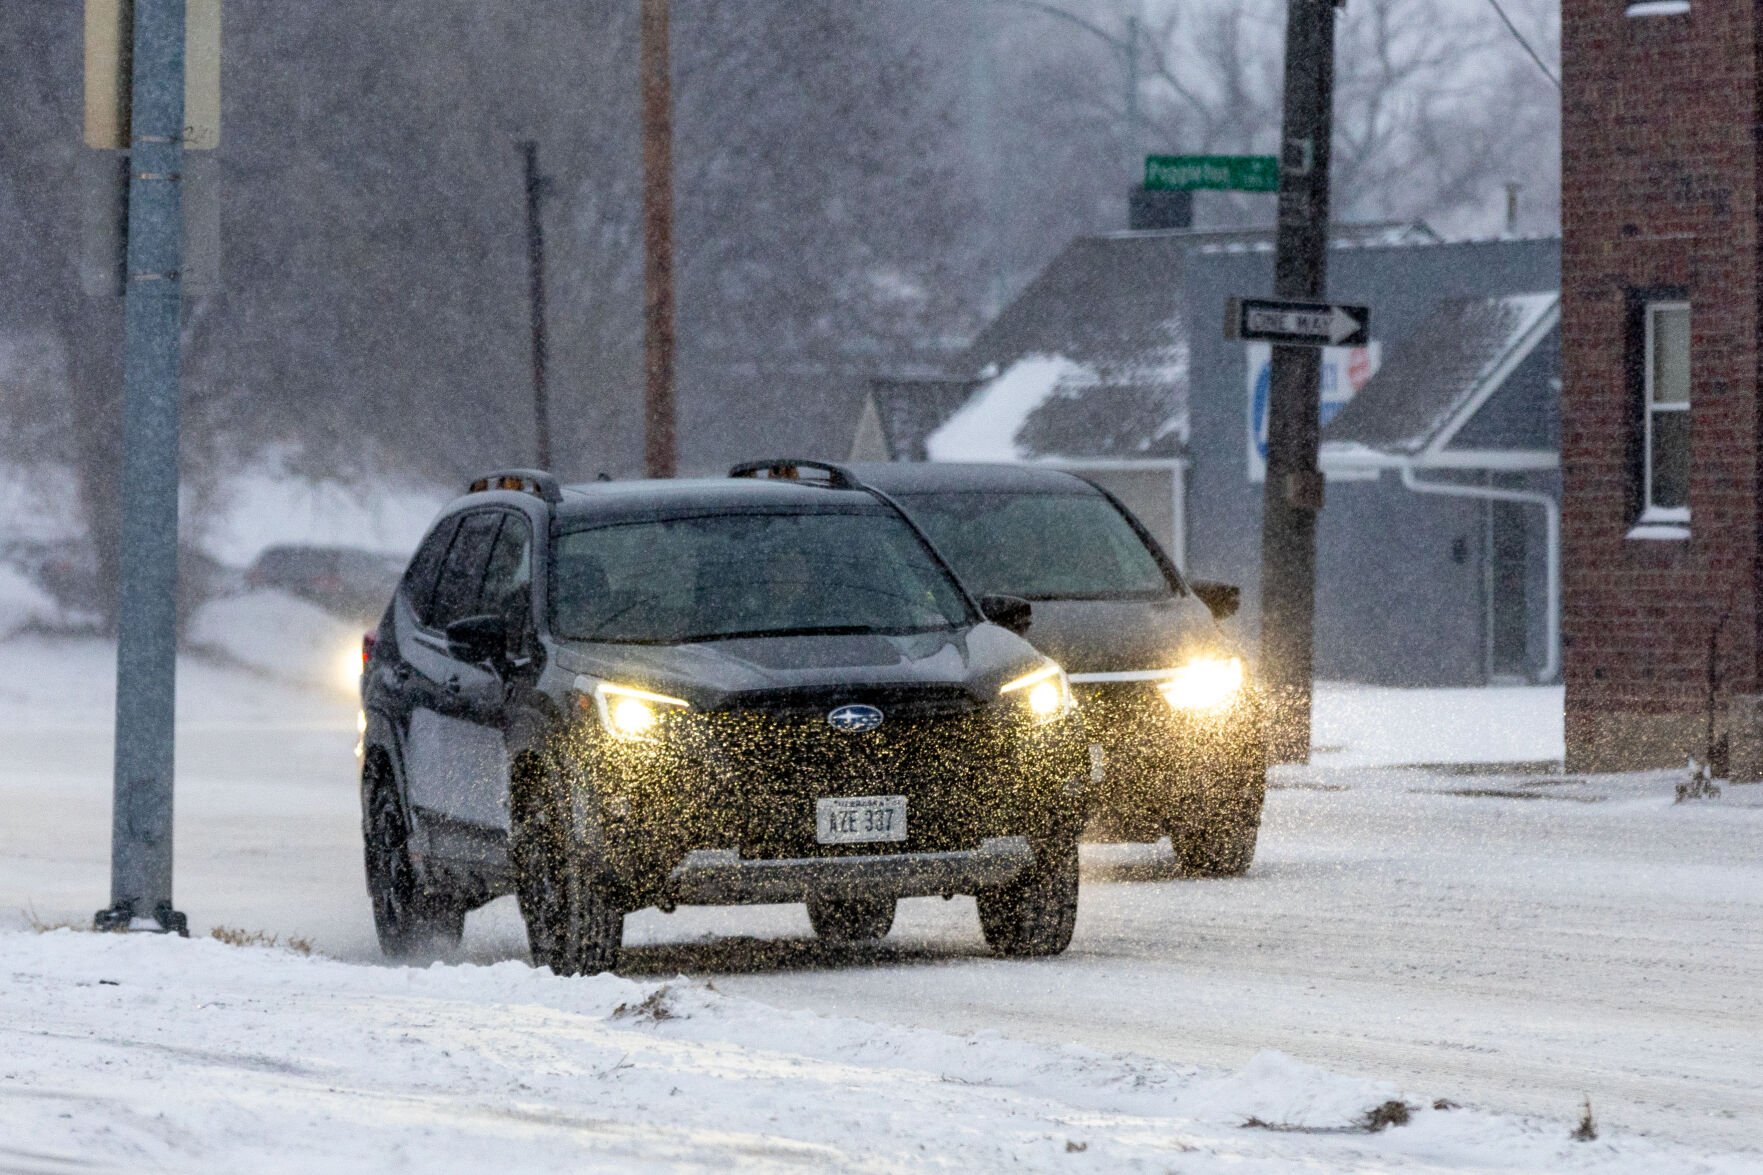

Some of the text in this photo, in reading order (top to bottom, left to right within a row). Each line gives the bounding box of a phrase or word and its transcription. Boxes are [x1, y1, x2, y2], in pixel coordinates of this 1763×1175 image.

[1253, 311, 1334, 334] ONE WAY
[829, 808, 894, 833] AZE 337
